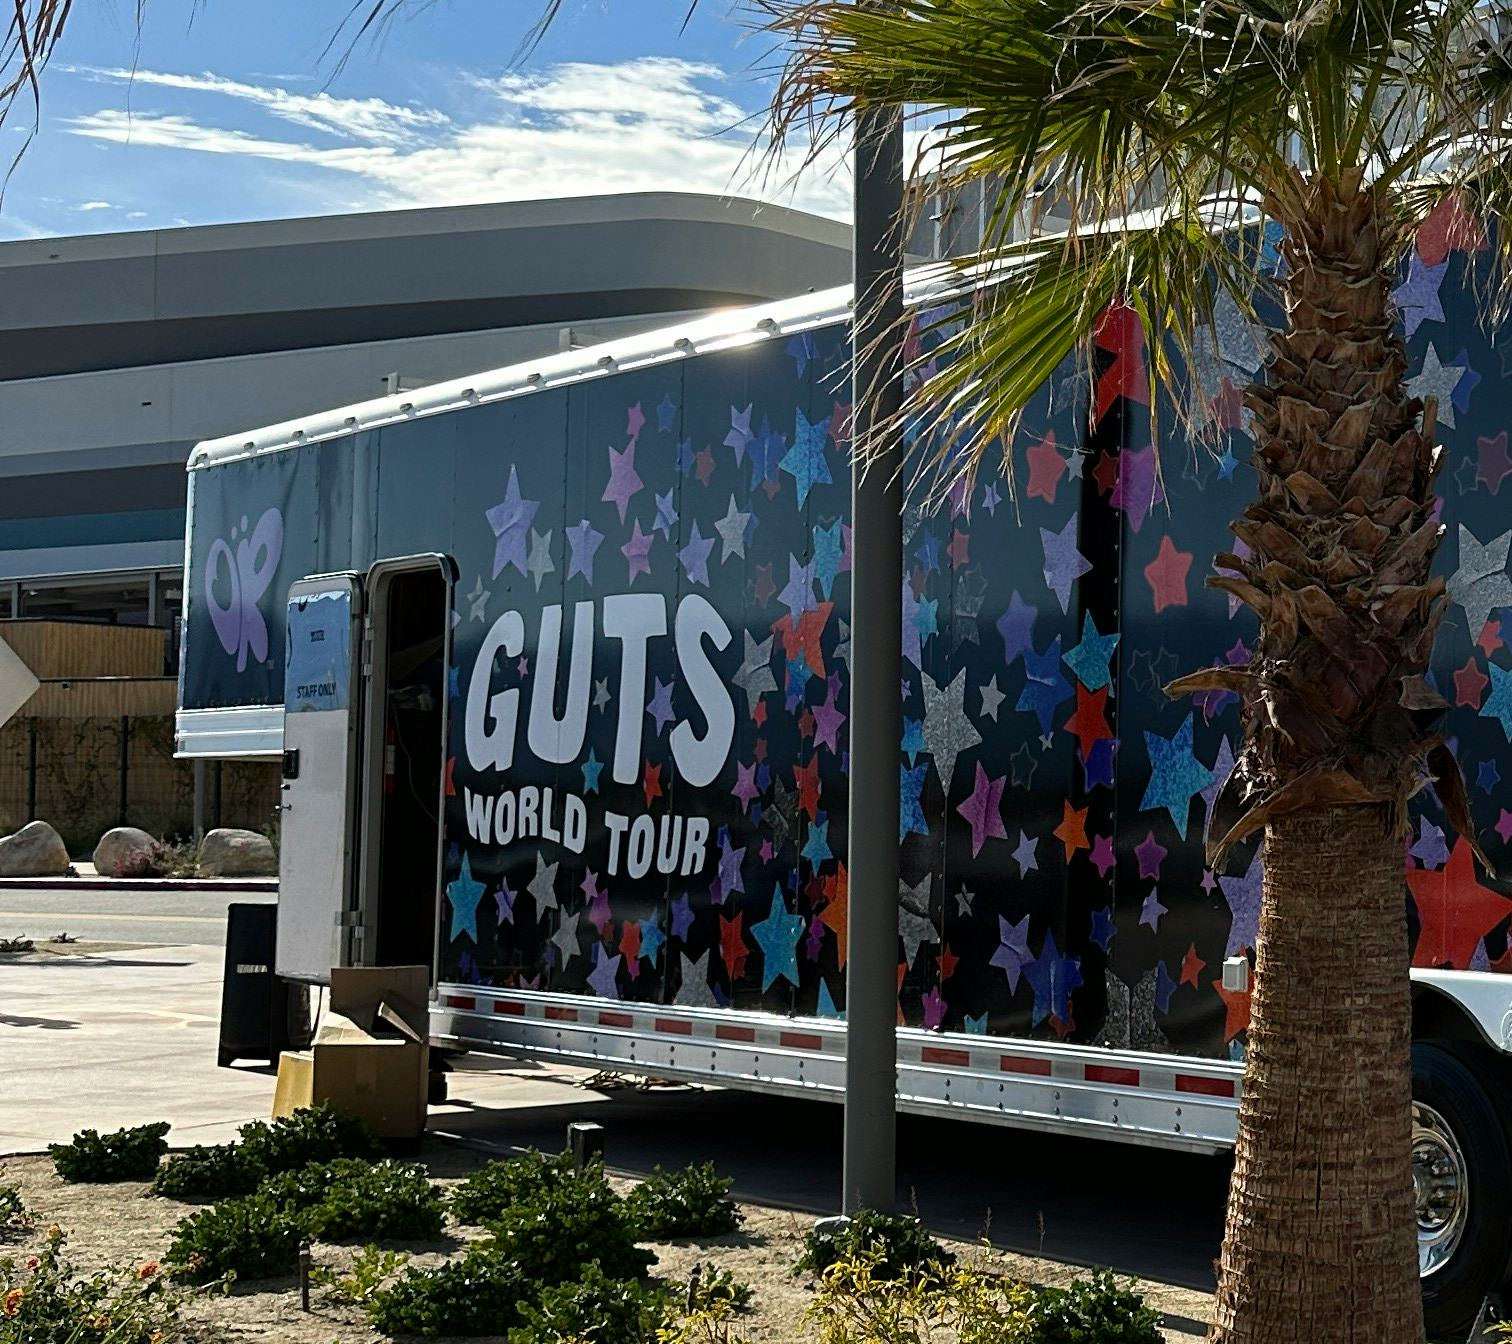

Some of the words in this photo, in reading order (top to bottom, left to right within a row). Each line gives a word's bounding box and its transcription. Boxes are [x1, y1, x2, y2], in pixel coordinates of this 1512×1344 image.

[297, 684, 318, 699] STAFF
[318, 682, 337, 697] ONLY
[464, 592, 736, 788] GUTS
[463, 785, 587, 855] WORLD
[603, 811, 710, 880] TOUR
